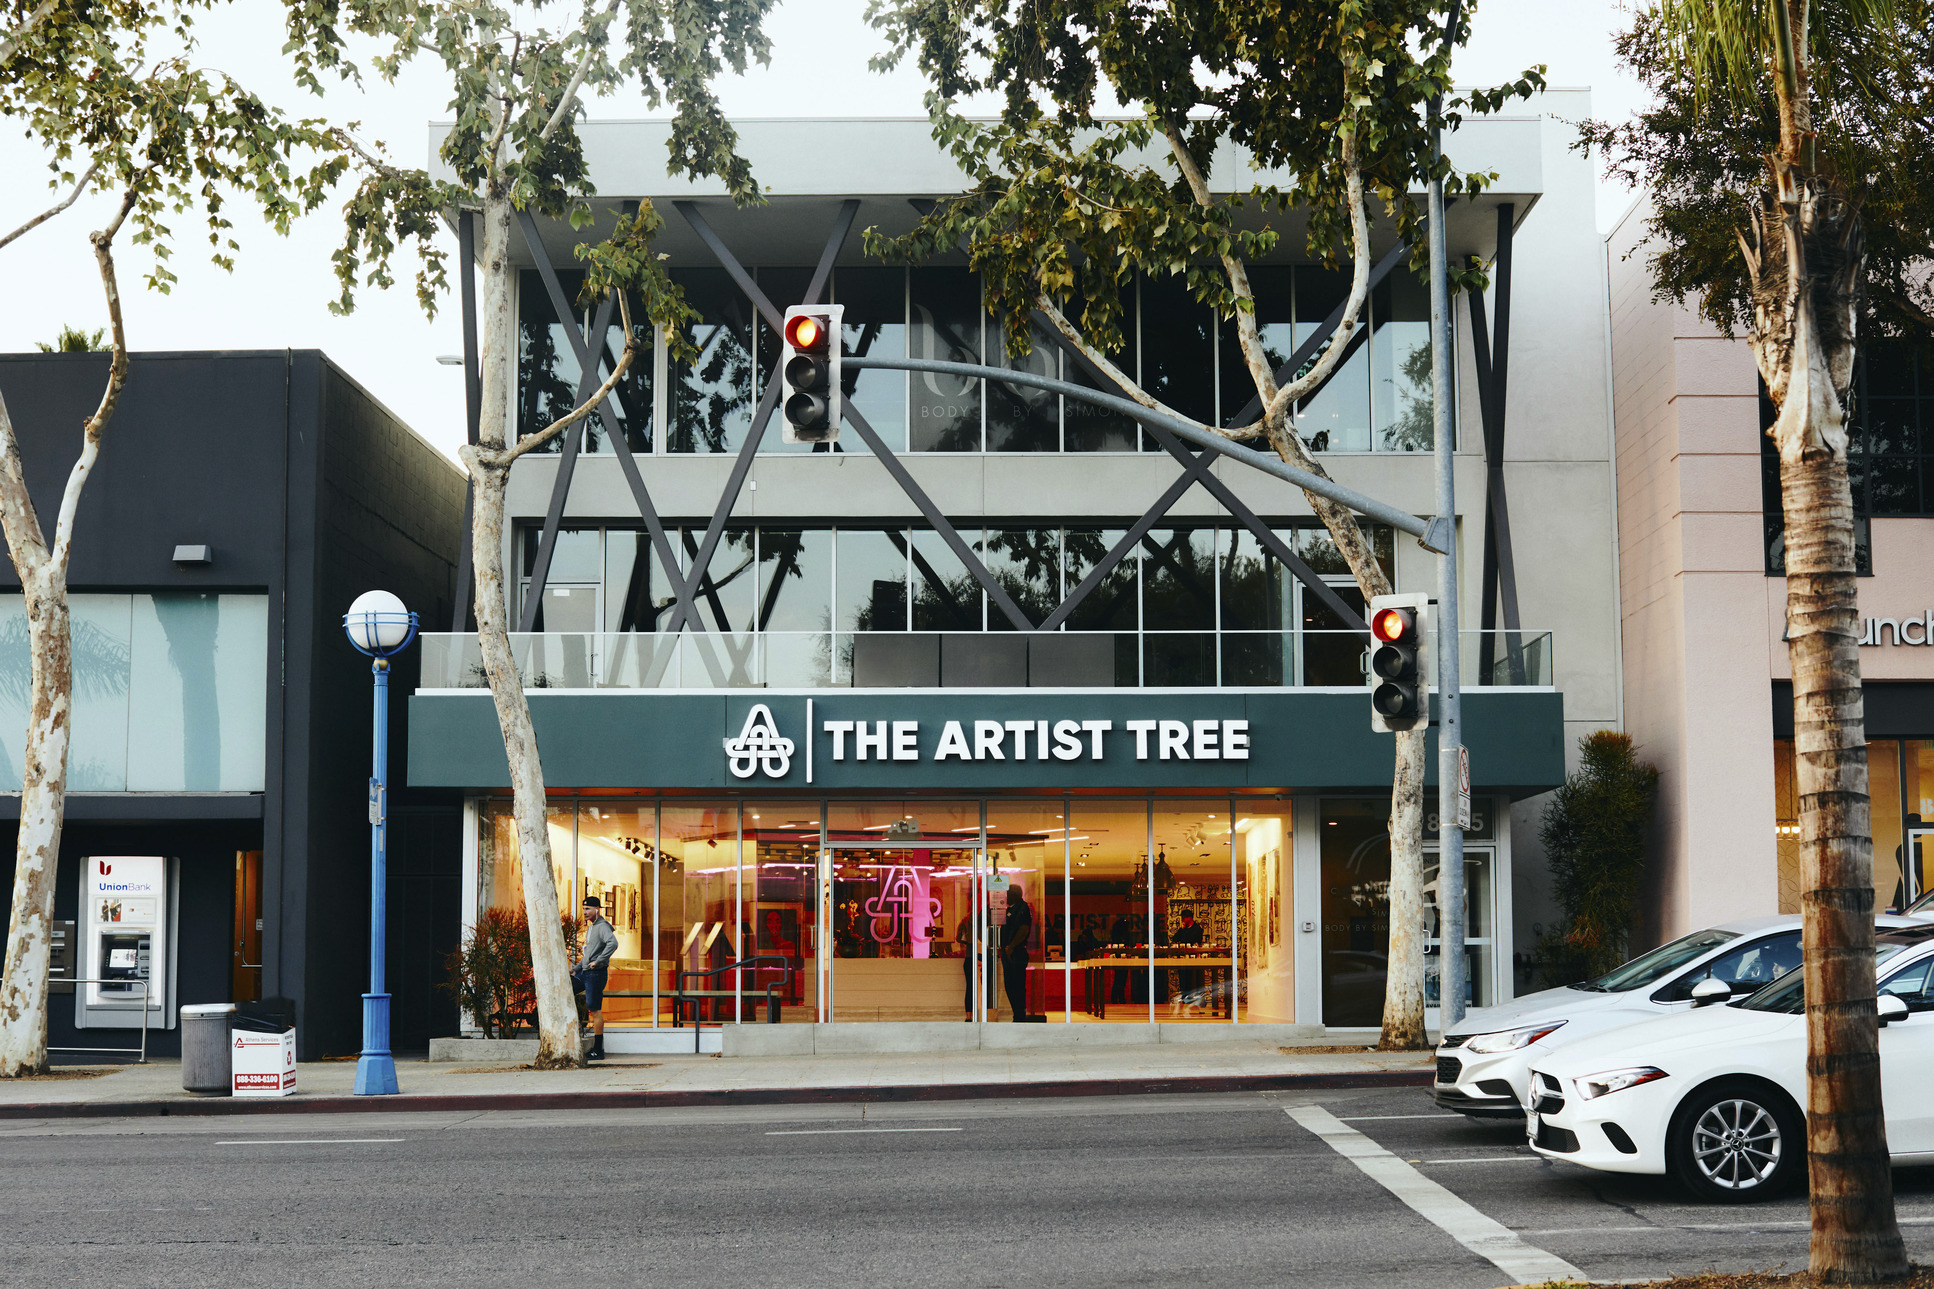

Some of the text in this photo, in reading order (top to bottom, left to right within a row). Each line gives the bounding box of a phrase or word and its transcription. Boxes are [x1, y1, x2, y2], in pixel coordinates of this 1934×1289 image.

[921, 405, 968, 418] BODY
[1013, 405, 1034, 418] BY
[823, 719, 1249, 761] THE ARTIST TREE
[99, 882, 151, 891] UnionBank
[1325, 924, 1350, 932] BODY
[1355, 924, 1366, 932] BY
